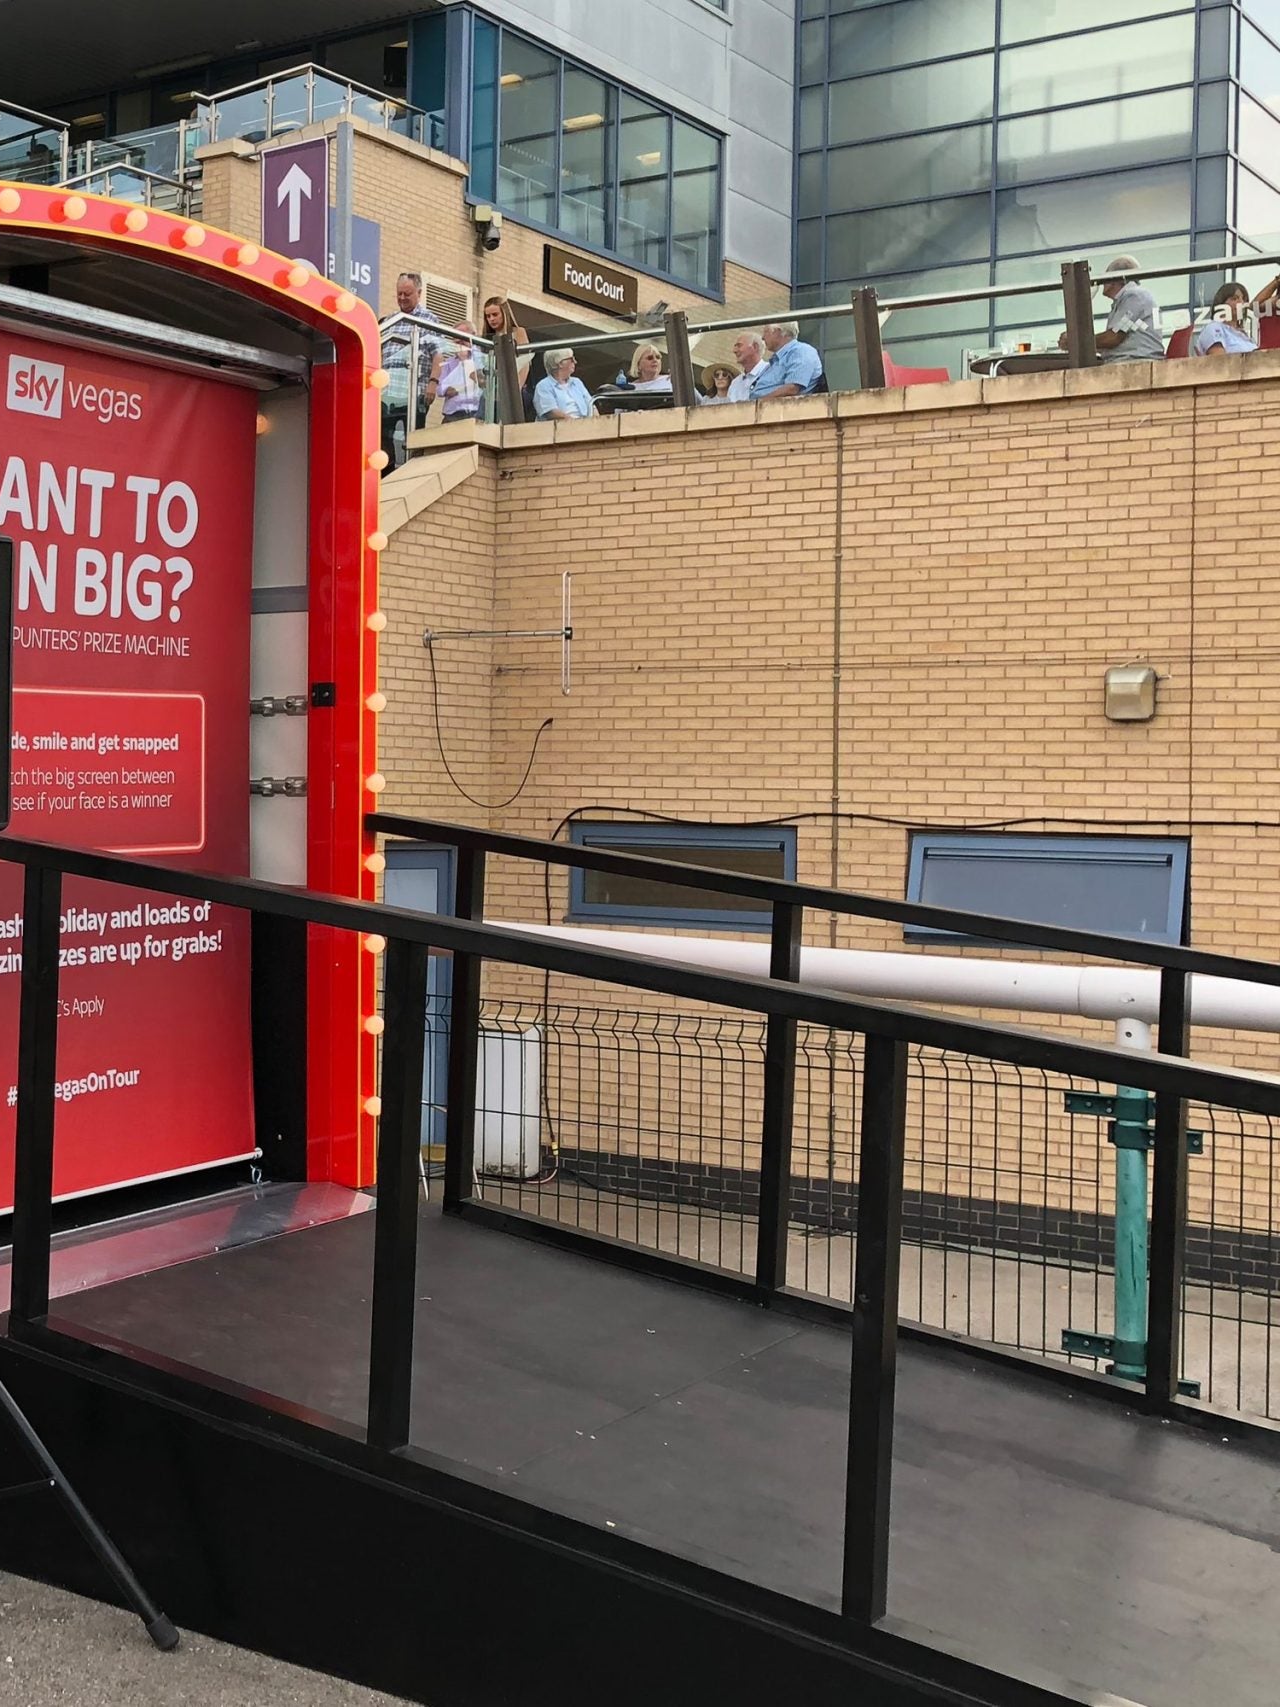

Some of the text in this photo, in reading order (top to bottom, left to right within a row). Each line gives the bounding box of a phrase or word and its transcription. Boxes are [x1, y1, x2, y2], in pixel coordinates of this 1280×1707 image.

[564, 262, 624, 302] Food Court
[1152, 299, 1280, 330] Lzaru
[14, 364, 142, 423] sky vegas
[126, 475, 199, 548] TO
[74, 548, 194, 623] BIG?
[83, 631, 122, 654] PRIZE
[124, 634, 190, 657] MACHINE
[32, 731, 68, 750] smile
[70, 732, 96, 751] and
[98, 734, 120, 755] get
[122, 734, 179, 755] snapped
[32, 767, 53, 785] the
[56, 767, 74, 789] big
[77, 770, 118, 785] screen
[121, 767, 175, 785] between
[12, 791, 173, 814] see if your face is a winner
[59, 907, 107, 936] oliday
[110, 903, 142, 929] and
[144, 900, 190, 926] loads
[193, 900, 211, 922] of
[90, 943, 117, 963] are
[120, 941, 141, 966] up
[144, 934, 169, 958] for
[172, 929, 222, 961] grabs!
[72, 995, 105, 1018] Apply
